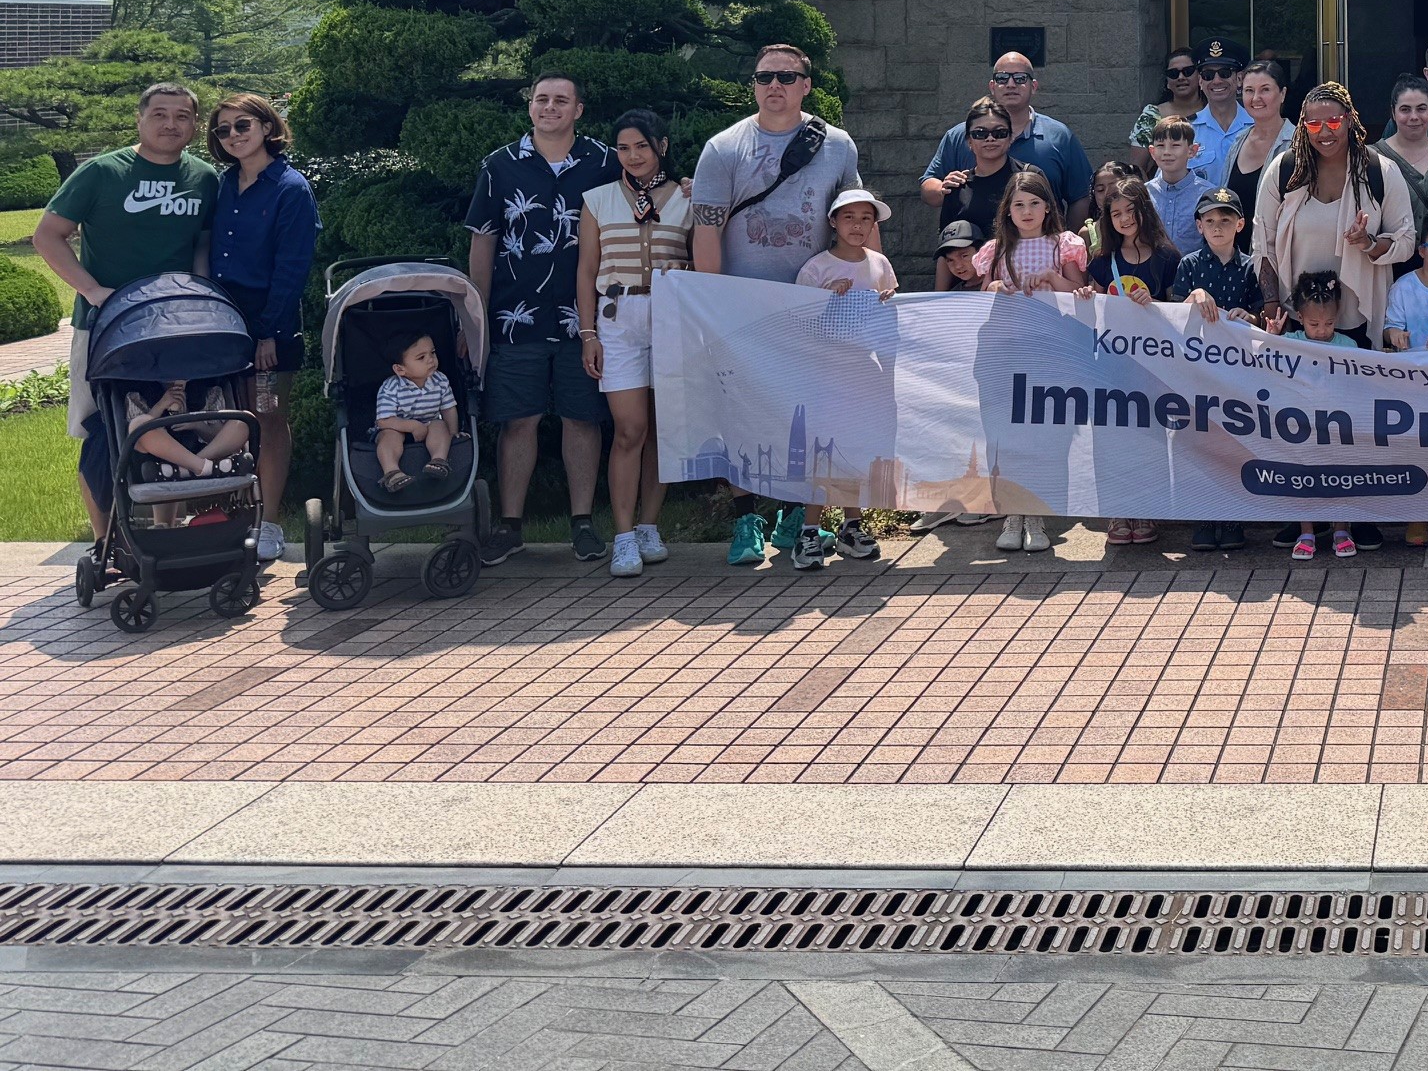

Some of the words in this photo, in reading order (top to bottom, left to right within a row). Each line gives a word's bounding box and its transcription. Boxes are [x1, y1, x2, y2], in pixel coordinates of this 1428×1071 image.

[134, 180, 176, 198] JUST
[160, 197, 187, 216] DO
[186, 198, 202, 216] IT
[1093, 328, 1174, 358] Korea
[1183, 336, 1302, 379] Security
[1011, 372, 1354, 445] Immersion
[1255, 467, 1286, 486] We
[1290, 474, 1315, 490] go
[1319, 471, 1411, 490] together!
